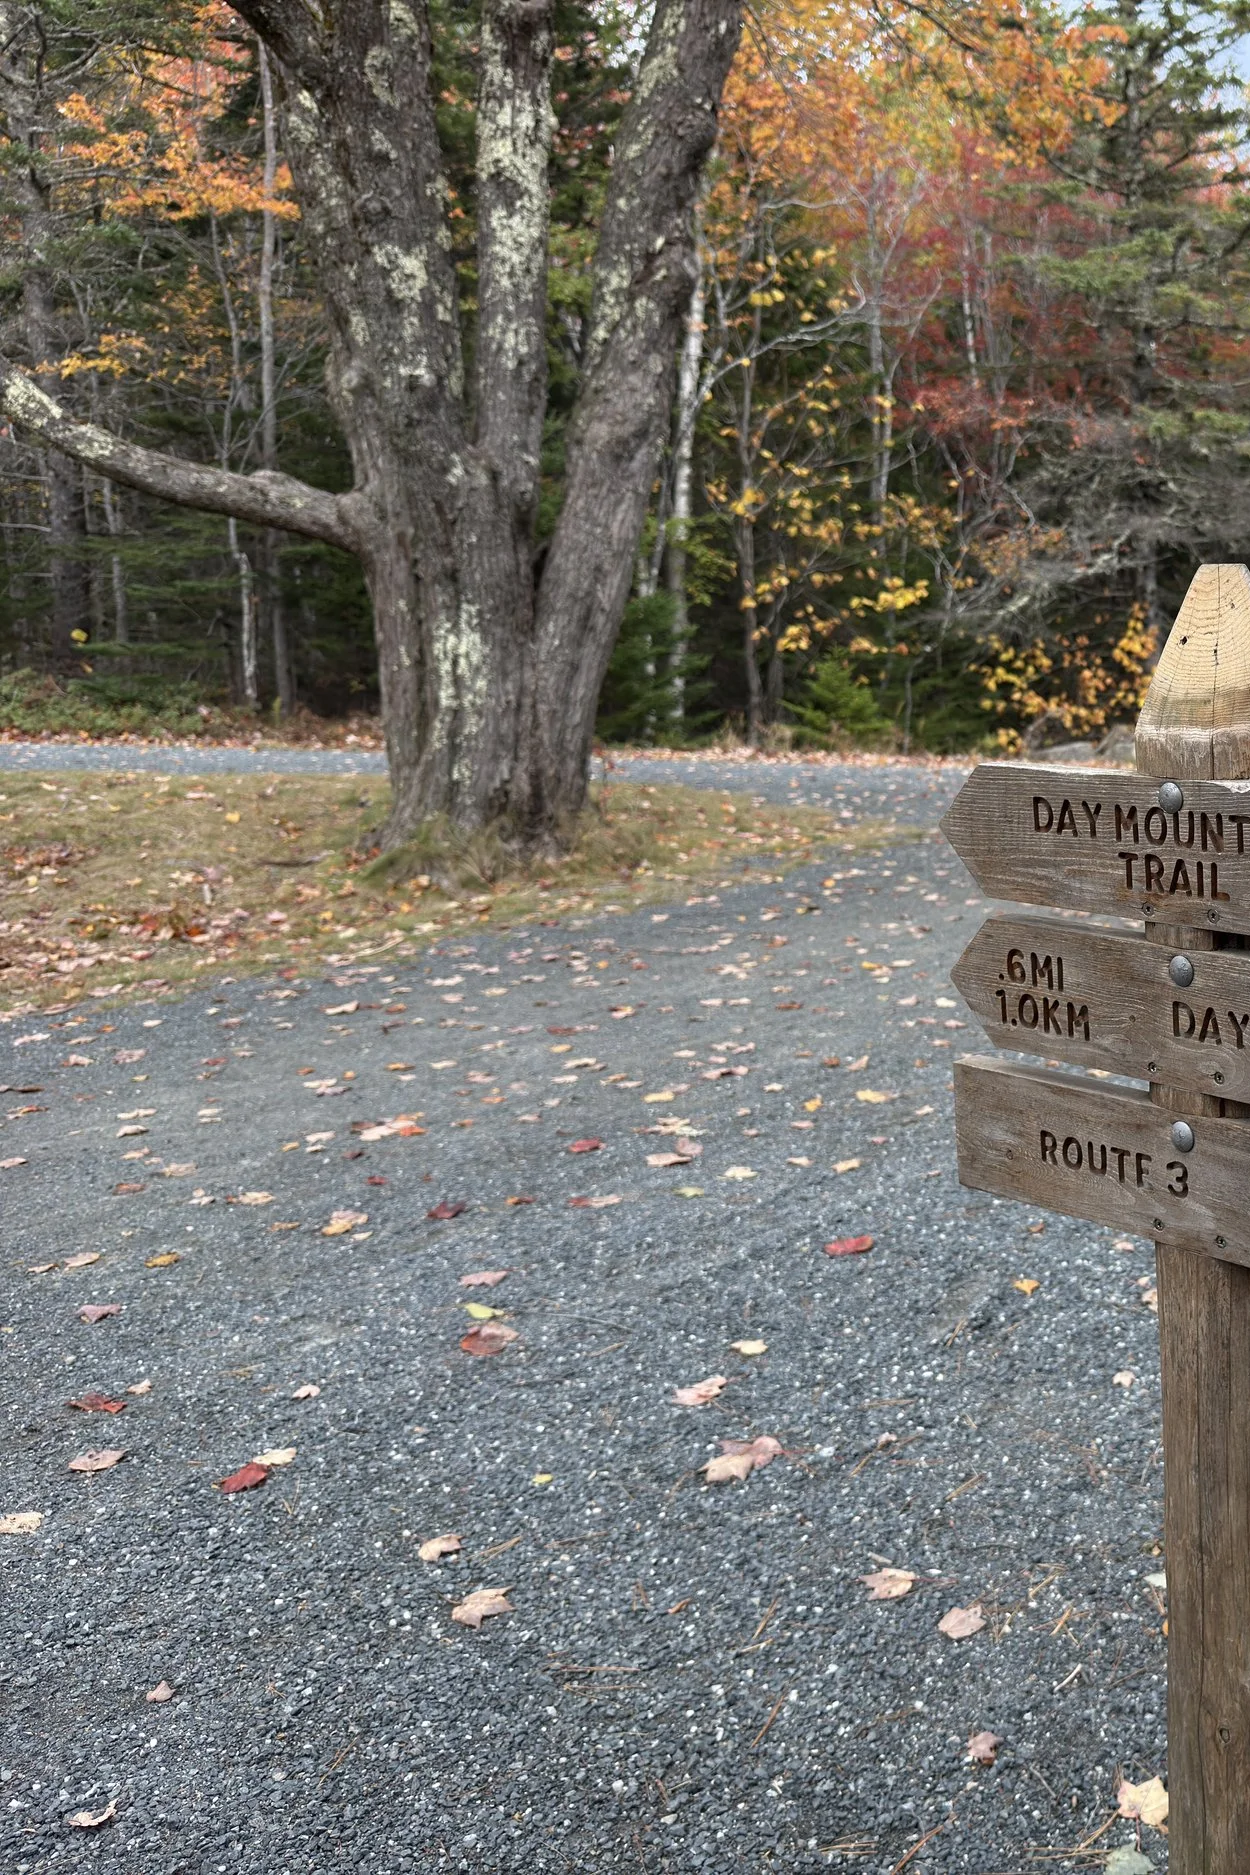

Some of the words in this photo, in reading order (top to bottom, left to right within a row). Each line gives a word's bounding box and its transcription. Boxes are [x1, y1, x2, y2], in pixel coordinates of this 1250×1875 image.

[1032, 796, 1101, 838] DAY
[1118, 851, 1230, 900] TRAIL
[1172, 1000, 1249, 1049] DAY
[1166, 1160, 1189, 1198] 3
